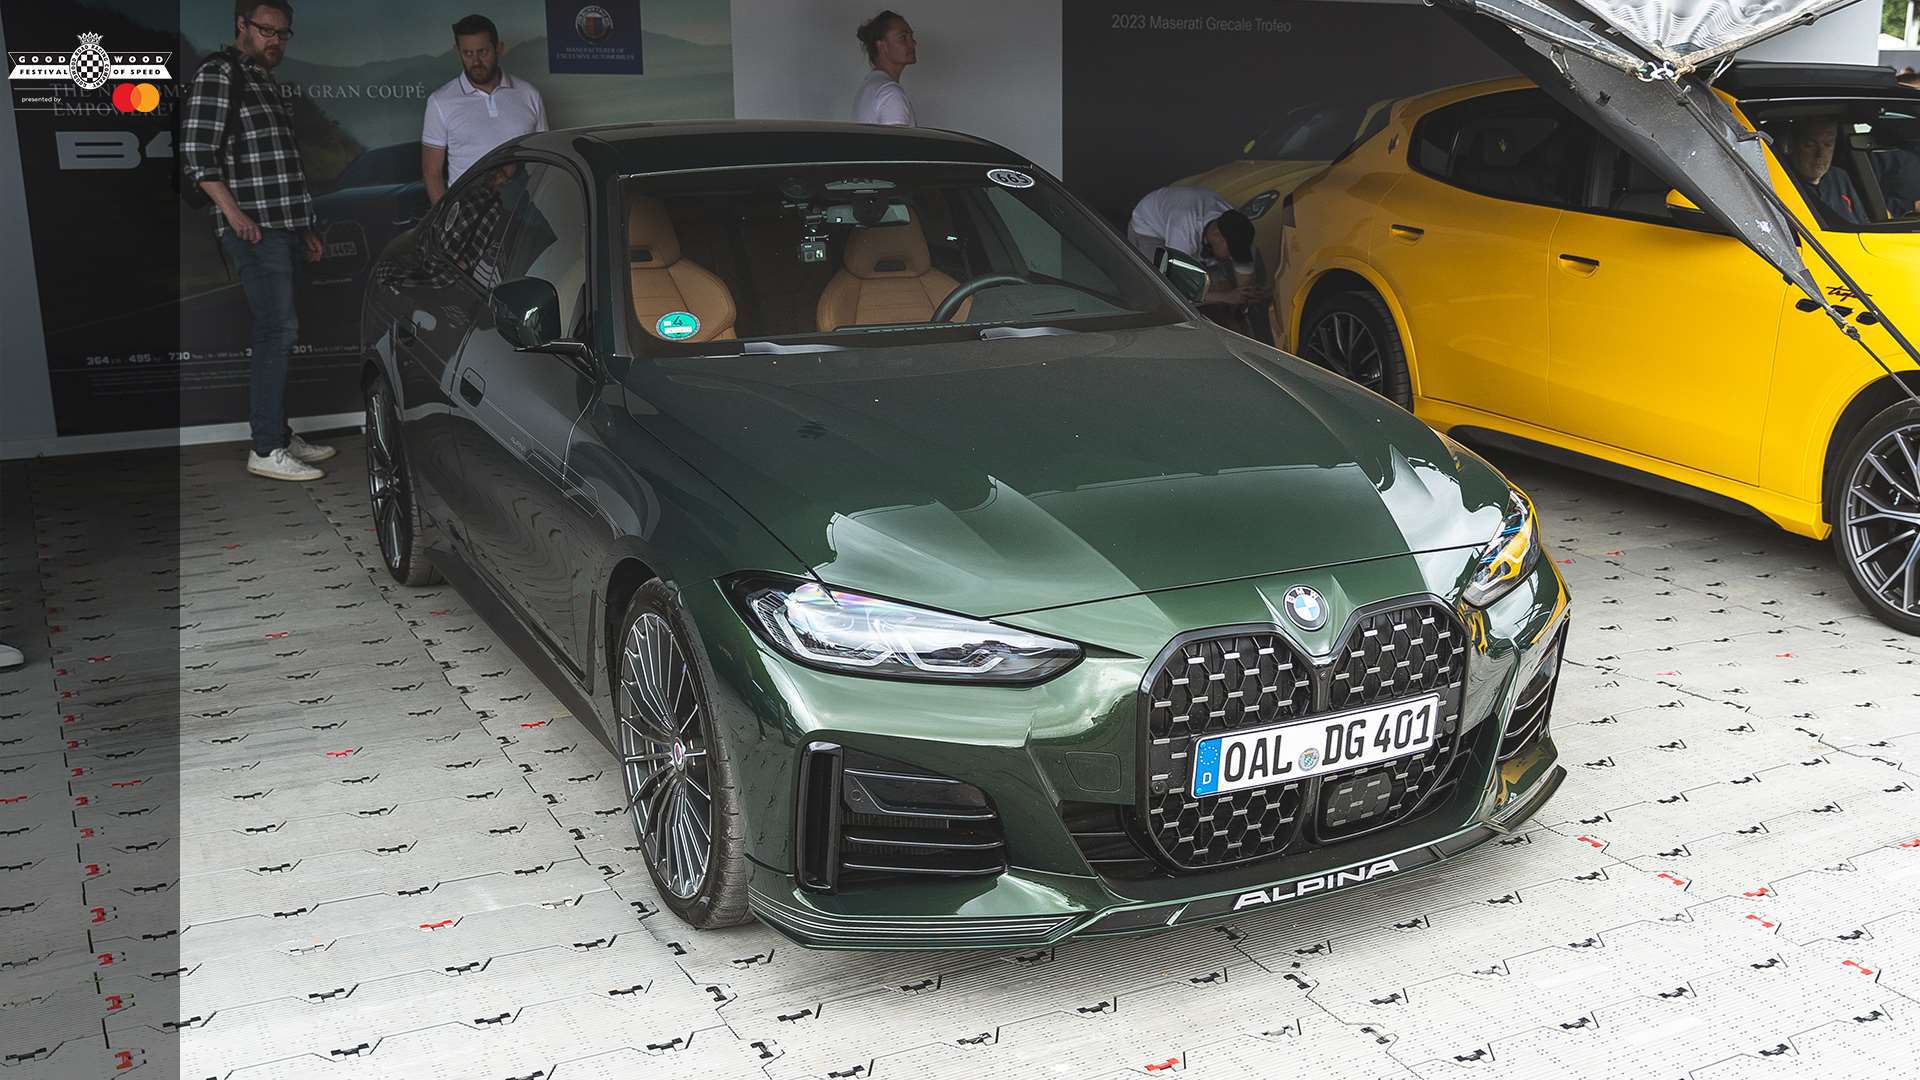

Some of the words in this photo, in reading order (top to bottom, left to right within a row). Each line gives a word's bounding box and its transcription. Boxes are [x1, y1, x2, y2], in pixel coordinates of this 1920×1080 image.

[1111, 14, 1146, 29] 2023
[1150, 15, 1203, 30] Maserati
[1206, 16, 1252, 31] Grecale
[1254, 17, 1292, 32] Trofeo
[281, 85, 302, 98] B4
[308, 84, 361, 98] GRAN
[366, 81, 426, 98] COUPÉ
[1286, 587, 1319, 603] BMW
[1202, 772, 1212, 785] D
[1224, 734, 1293, 783] OAL
[1321, 719, 1367, 766] DG
[1373, 704, 1431, 753] 401
[1232, 858, 1399, 911] ALPINA
